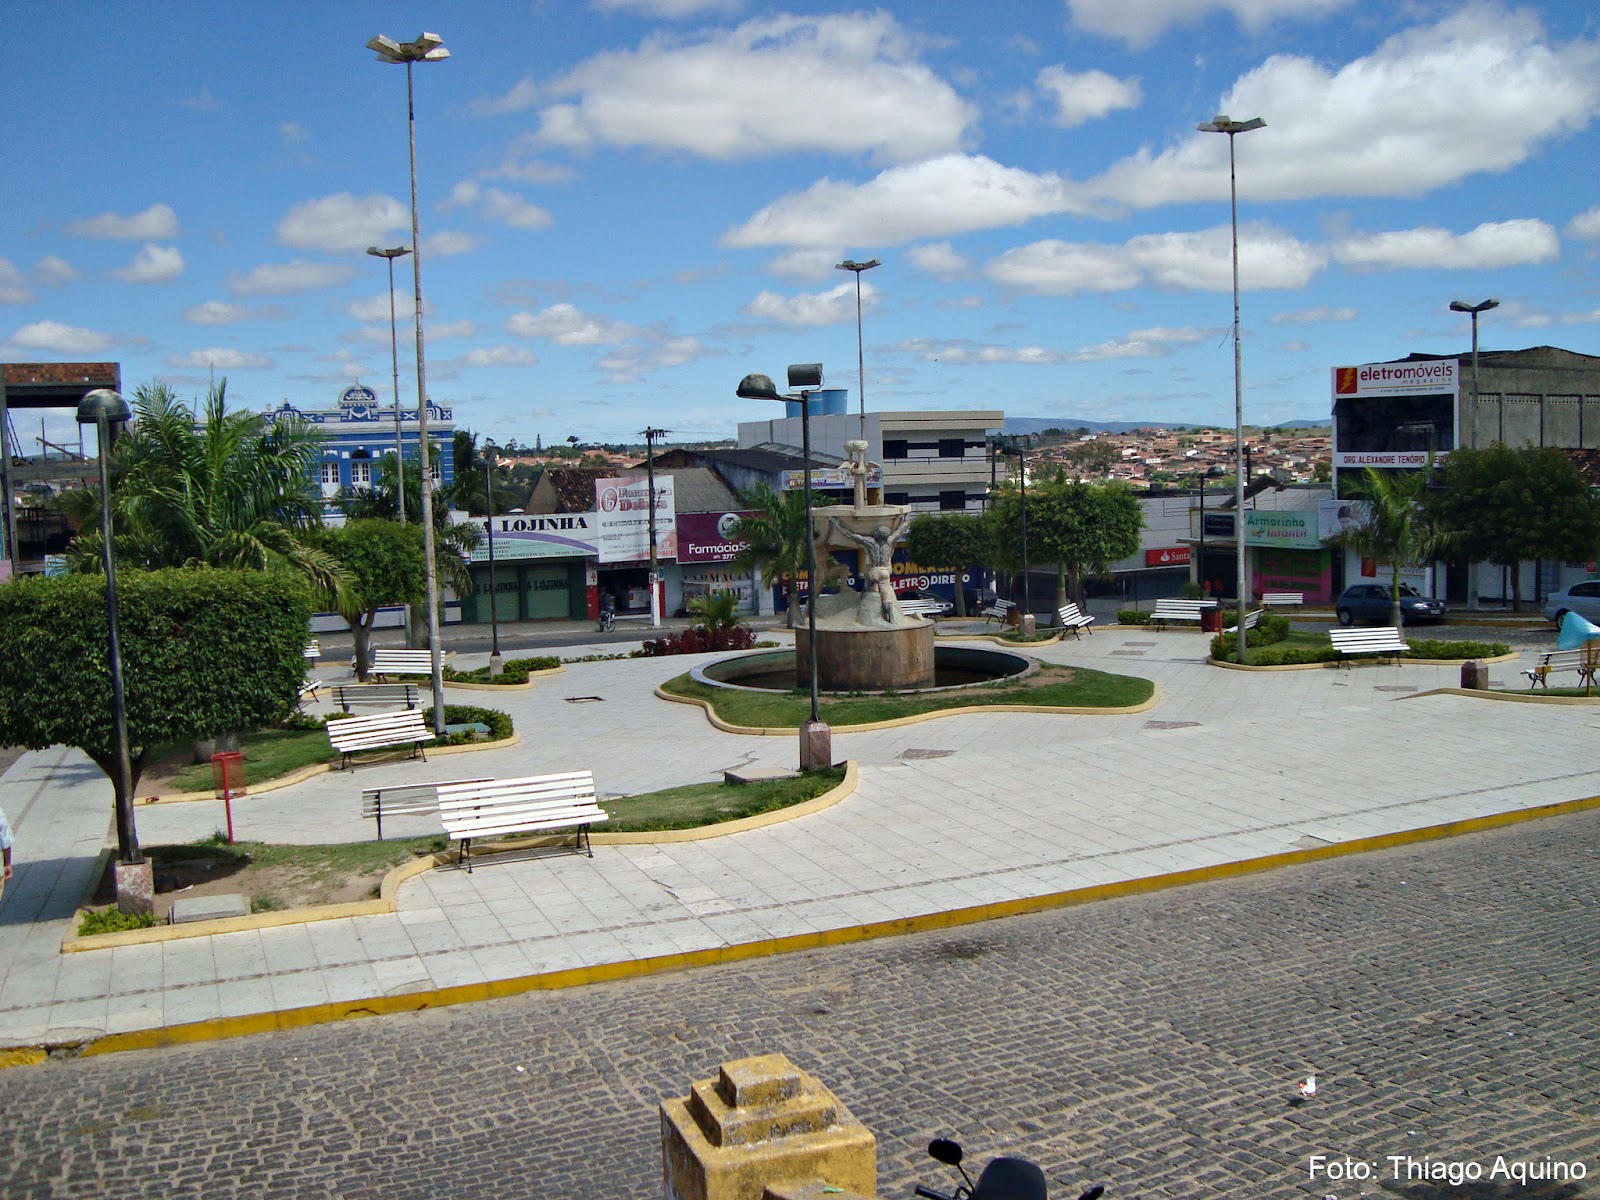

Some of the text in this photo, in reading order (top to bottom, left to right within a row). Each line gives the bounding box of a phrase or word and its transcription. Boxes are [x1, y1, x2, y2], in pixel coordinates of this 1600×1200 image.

[1360, 362, 1453, 381] eletromóveis
[502, 517, 588, 532] LOJINHA
[1247, 515, 1305, 527] Armarinho
[1171, 551, 1190, 561] Santa
